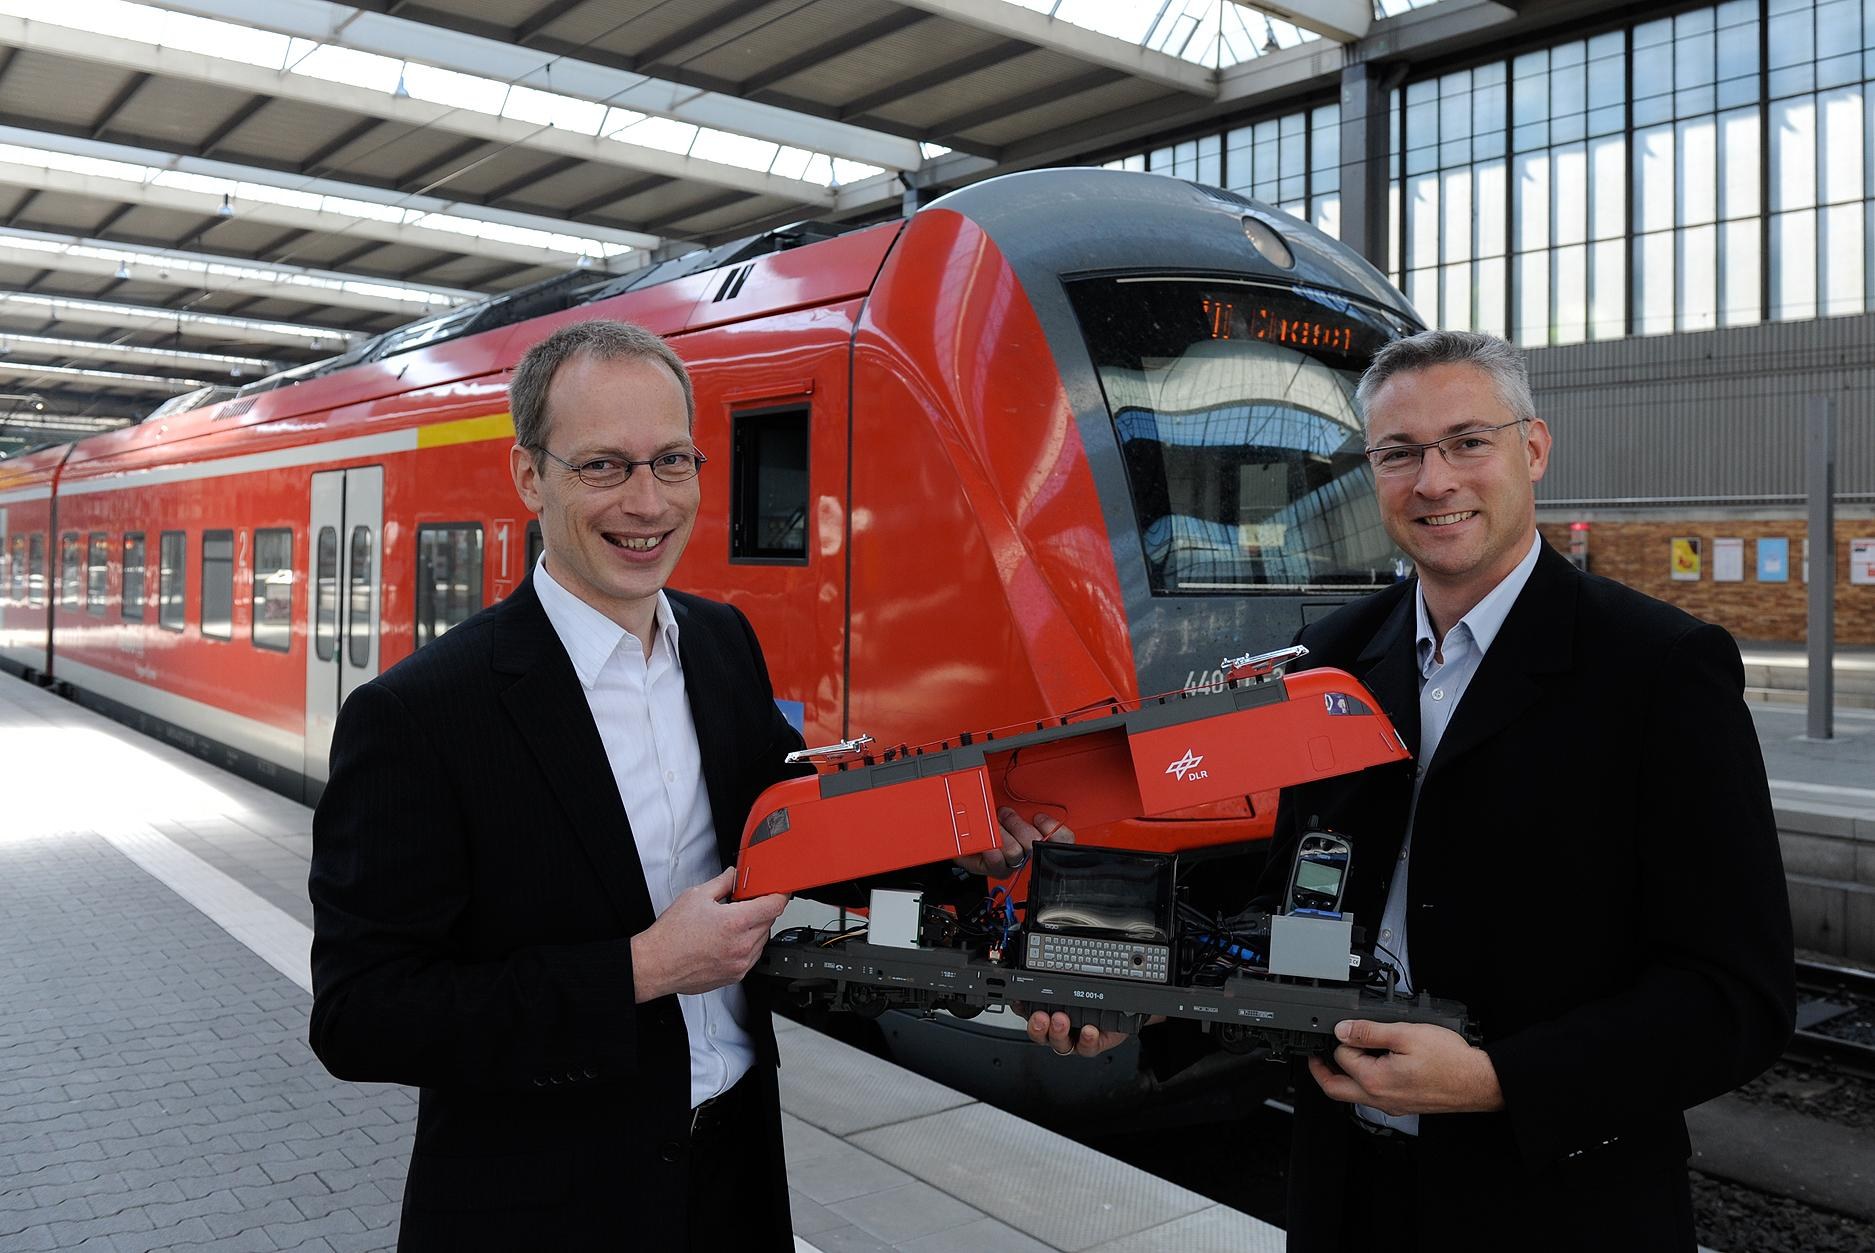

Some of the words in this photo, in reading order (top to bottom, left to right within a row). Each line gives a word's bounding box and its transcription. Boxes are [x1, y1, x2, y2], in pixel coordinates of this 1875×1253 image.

[238, 530, 248, 567] 2
[498, 524, 508, 577] 1
[1184, 669, 1224, 697] 440
[1188, 770, 1208, 781] DLR
[1073, 990, 1085, 998] 182
